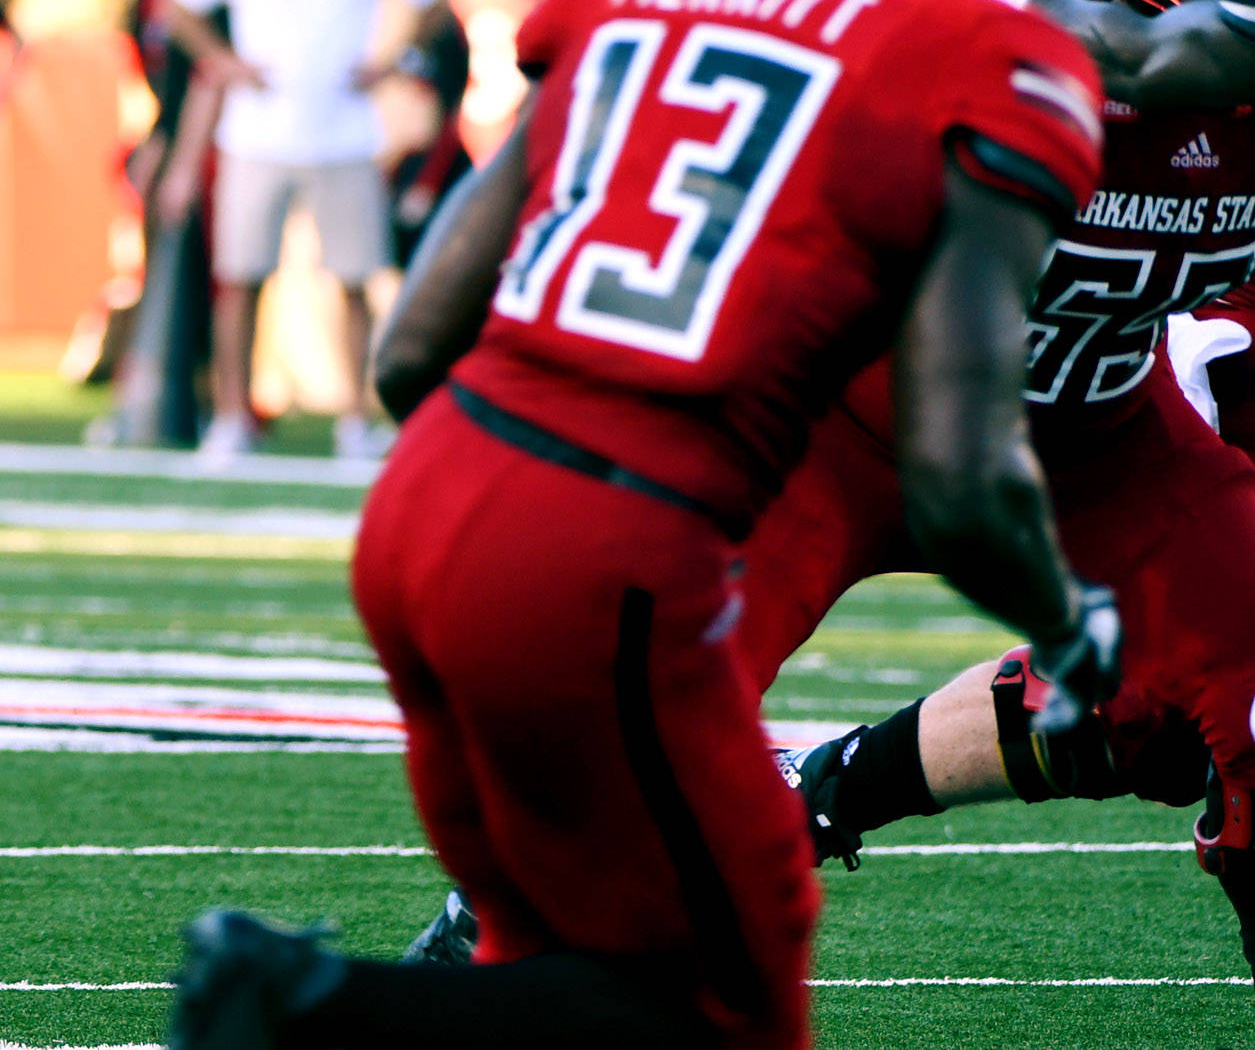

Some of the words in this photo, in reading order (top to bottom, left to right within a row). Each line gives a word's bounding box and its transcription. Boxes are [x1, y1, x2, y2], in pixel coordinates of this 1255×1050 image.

[1170, 154, 1219, 168] adidas
[492, 16, 842, 363] 13
[1074, 190, 1208, 234] RKANSAS
[1211, 195, 1255, 234] STA
